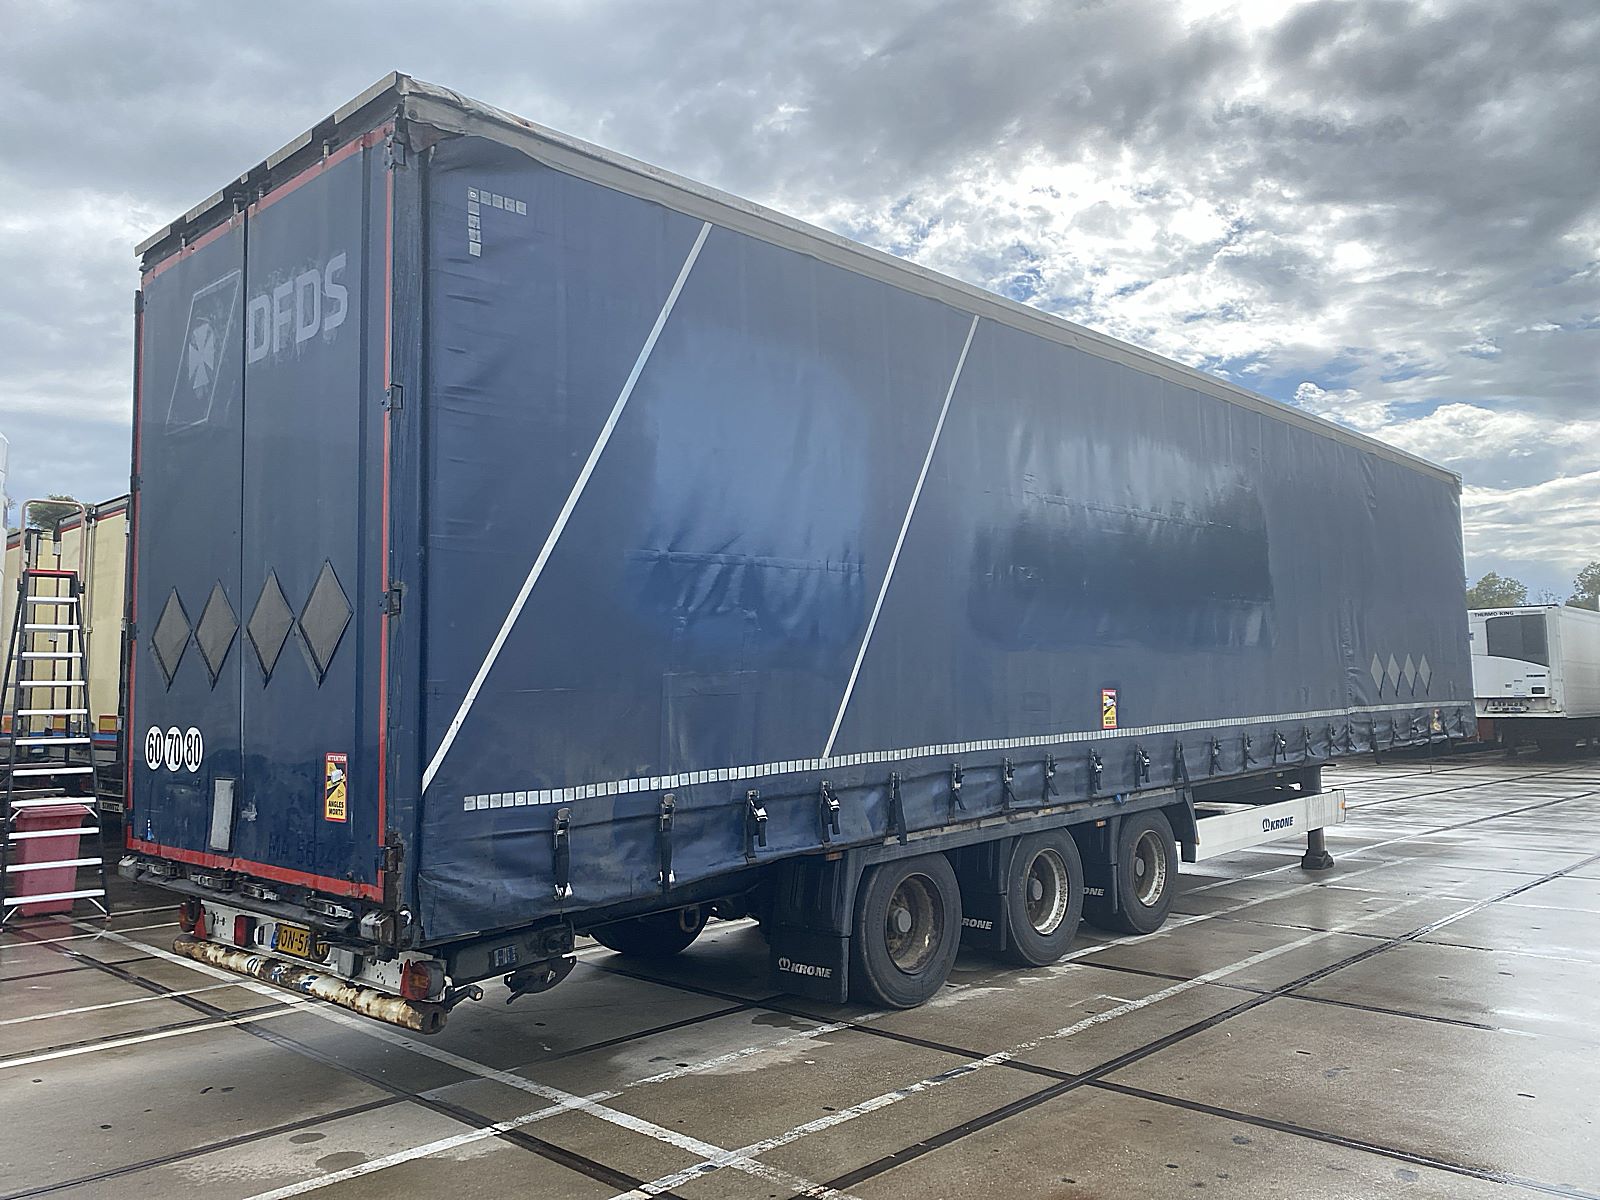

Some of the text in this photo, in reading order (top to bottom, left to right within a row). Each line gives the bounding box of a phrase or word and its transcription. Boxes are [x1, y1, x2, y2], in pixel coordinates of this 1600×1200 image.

[248, 252, 348, 364] DFDS
[147, 732, 201, 767] 60 70 80
[328, 800, 344, 808] ANGLES
[328, 808, 344, 816] MORTS
[1270, 816, 1294, 831] KRONE
[1083, 886, 1105, 897] ONE
[961, 917, 993, 931] RONE
[790, 962, 833, 979] KRONE
